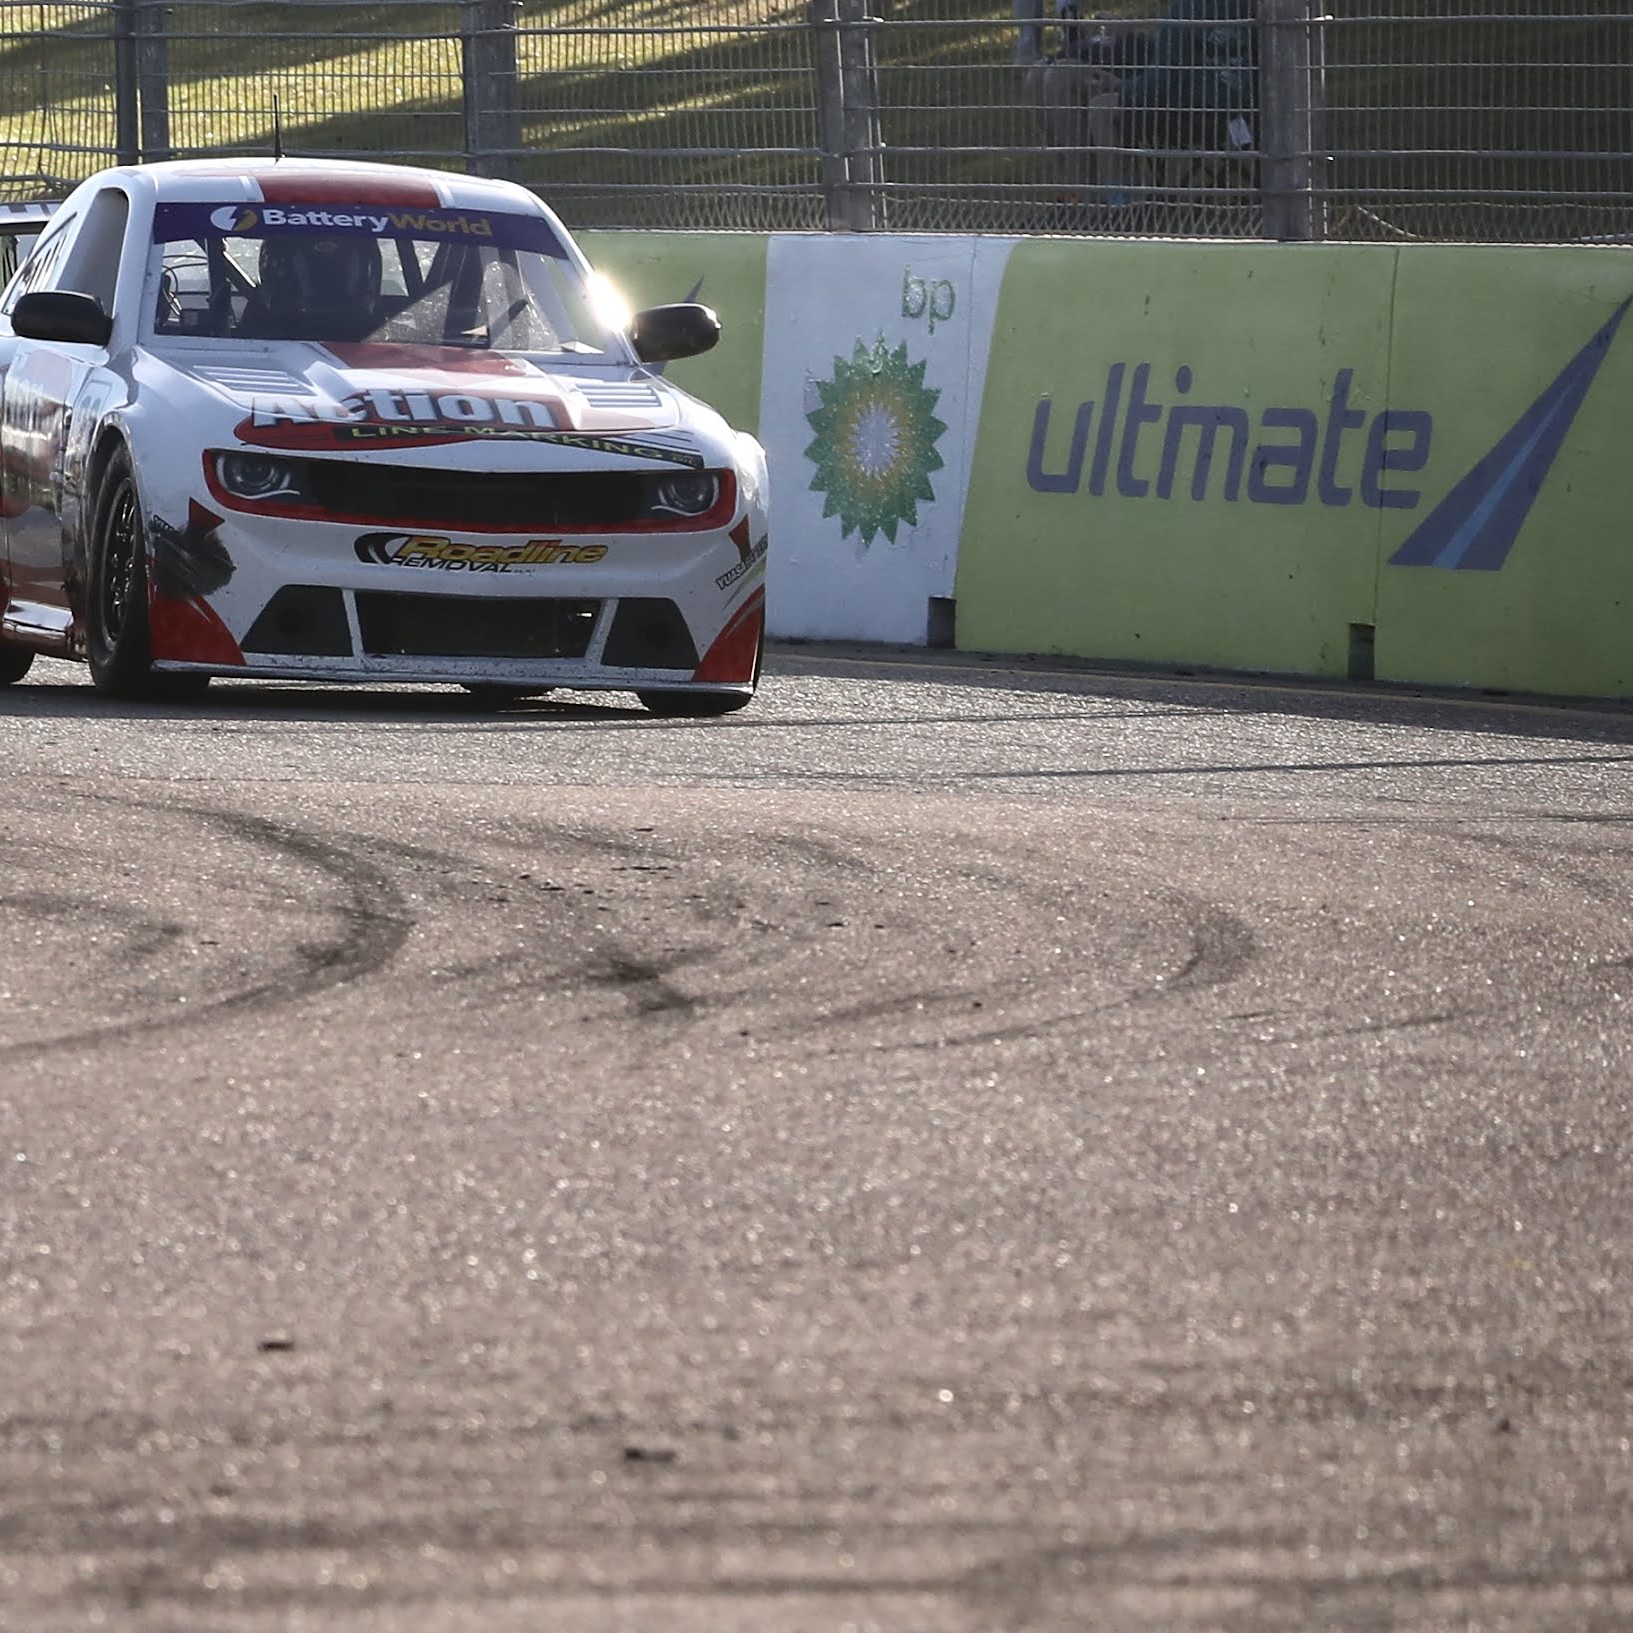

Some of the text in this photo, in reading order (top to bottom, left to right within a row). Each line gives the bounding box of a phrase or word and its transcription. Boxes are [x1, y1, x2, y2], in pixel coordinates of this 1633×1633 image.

[262, 209, 493, 237] BatteryWorld
[900, 264, 956, 336] bp
[252, 387, 559, 429] Action
[351, 426, 449, 439] LINE
[462, 426, 663, 459] MARKING
[1026, 362, 1434, 509] ultimate
[389, 555, 513, 574] REMOVAL
[395, 535, 609, 565] Roadline
